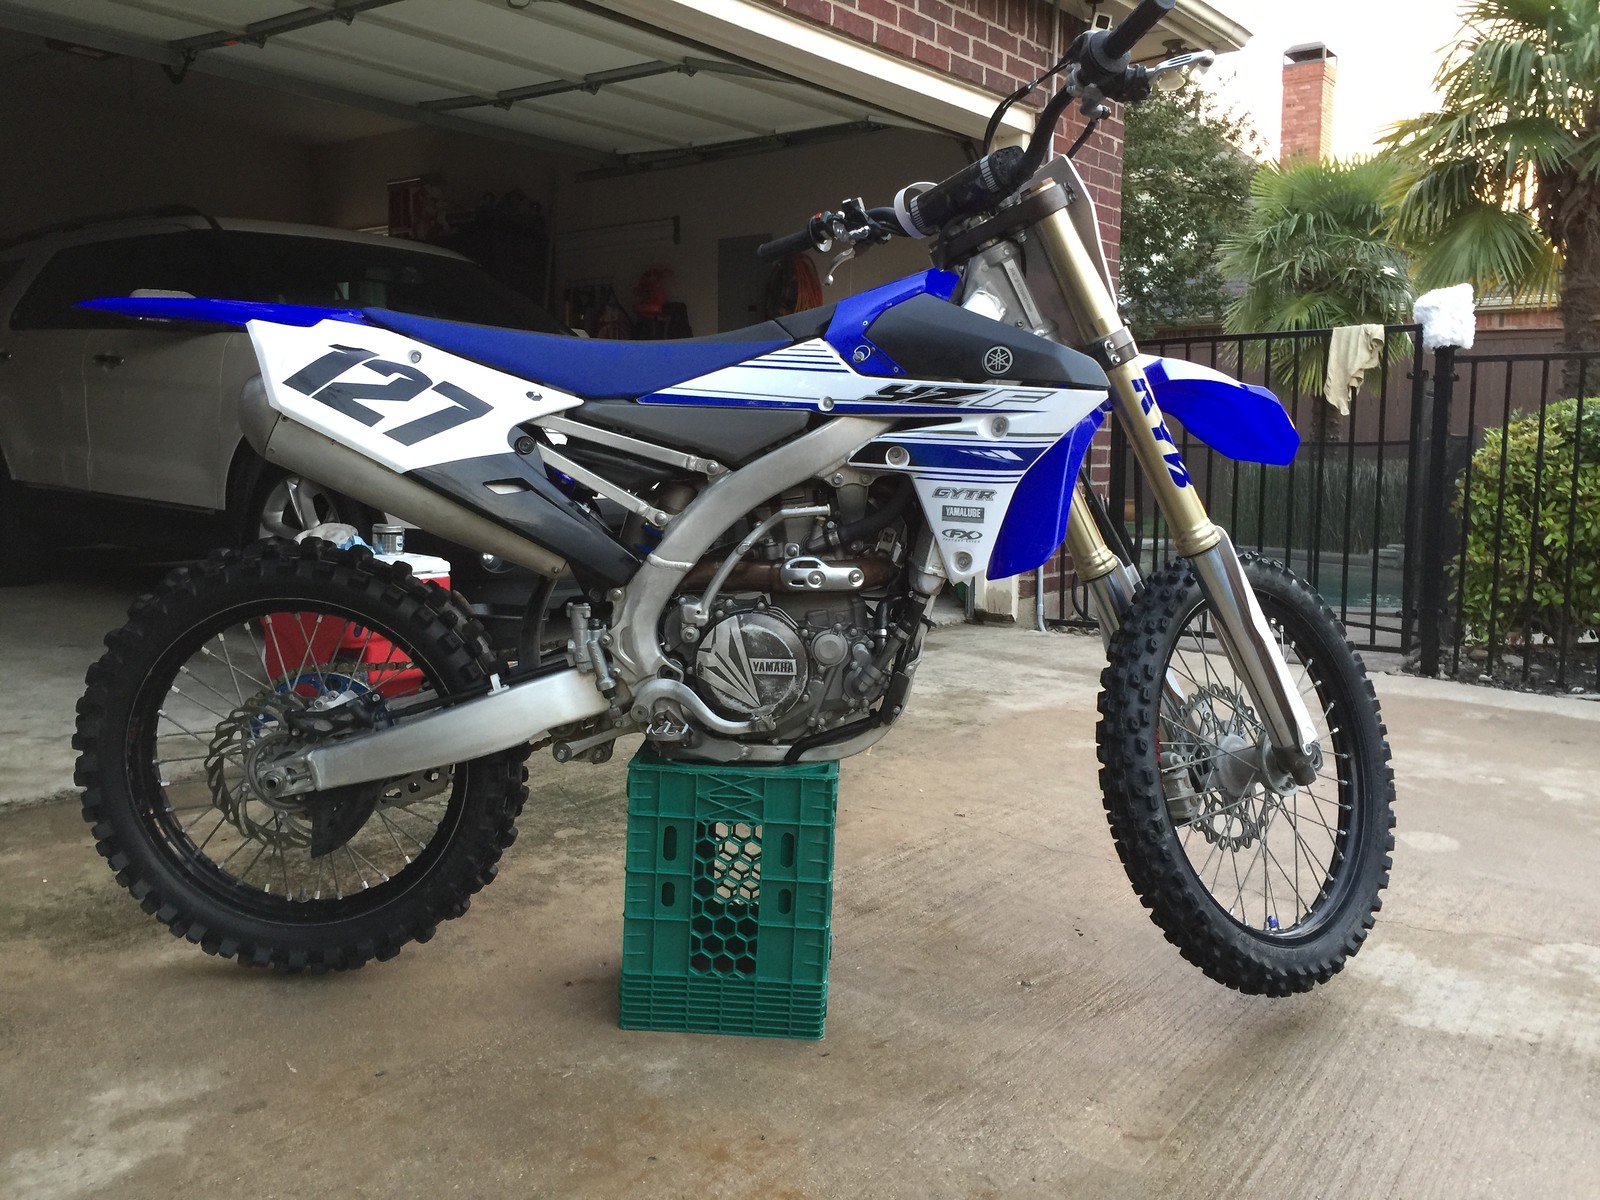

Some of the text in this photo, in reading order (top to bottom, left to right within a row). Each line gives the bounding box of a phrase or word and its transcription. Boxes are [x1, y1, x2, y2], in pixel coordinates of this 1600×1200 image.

[282, 343, 495, 446] 127
[931, 486, 998, 501] GYTR
[945, 506, 981, 518] YAMALUBE
[752, 661, 794, 673] YAMAHA
